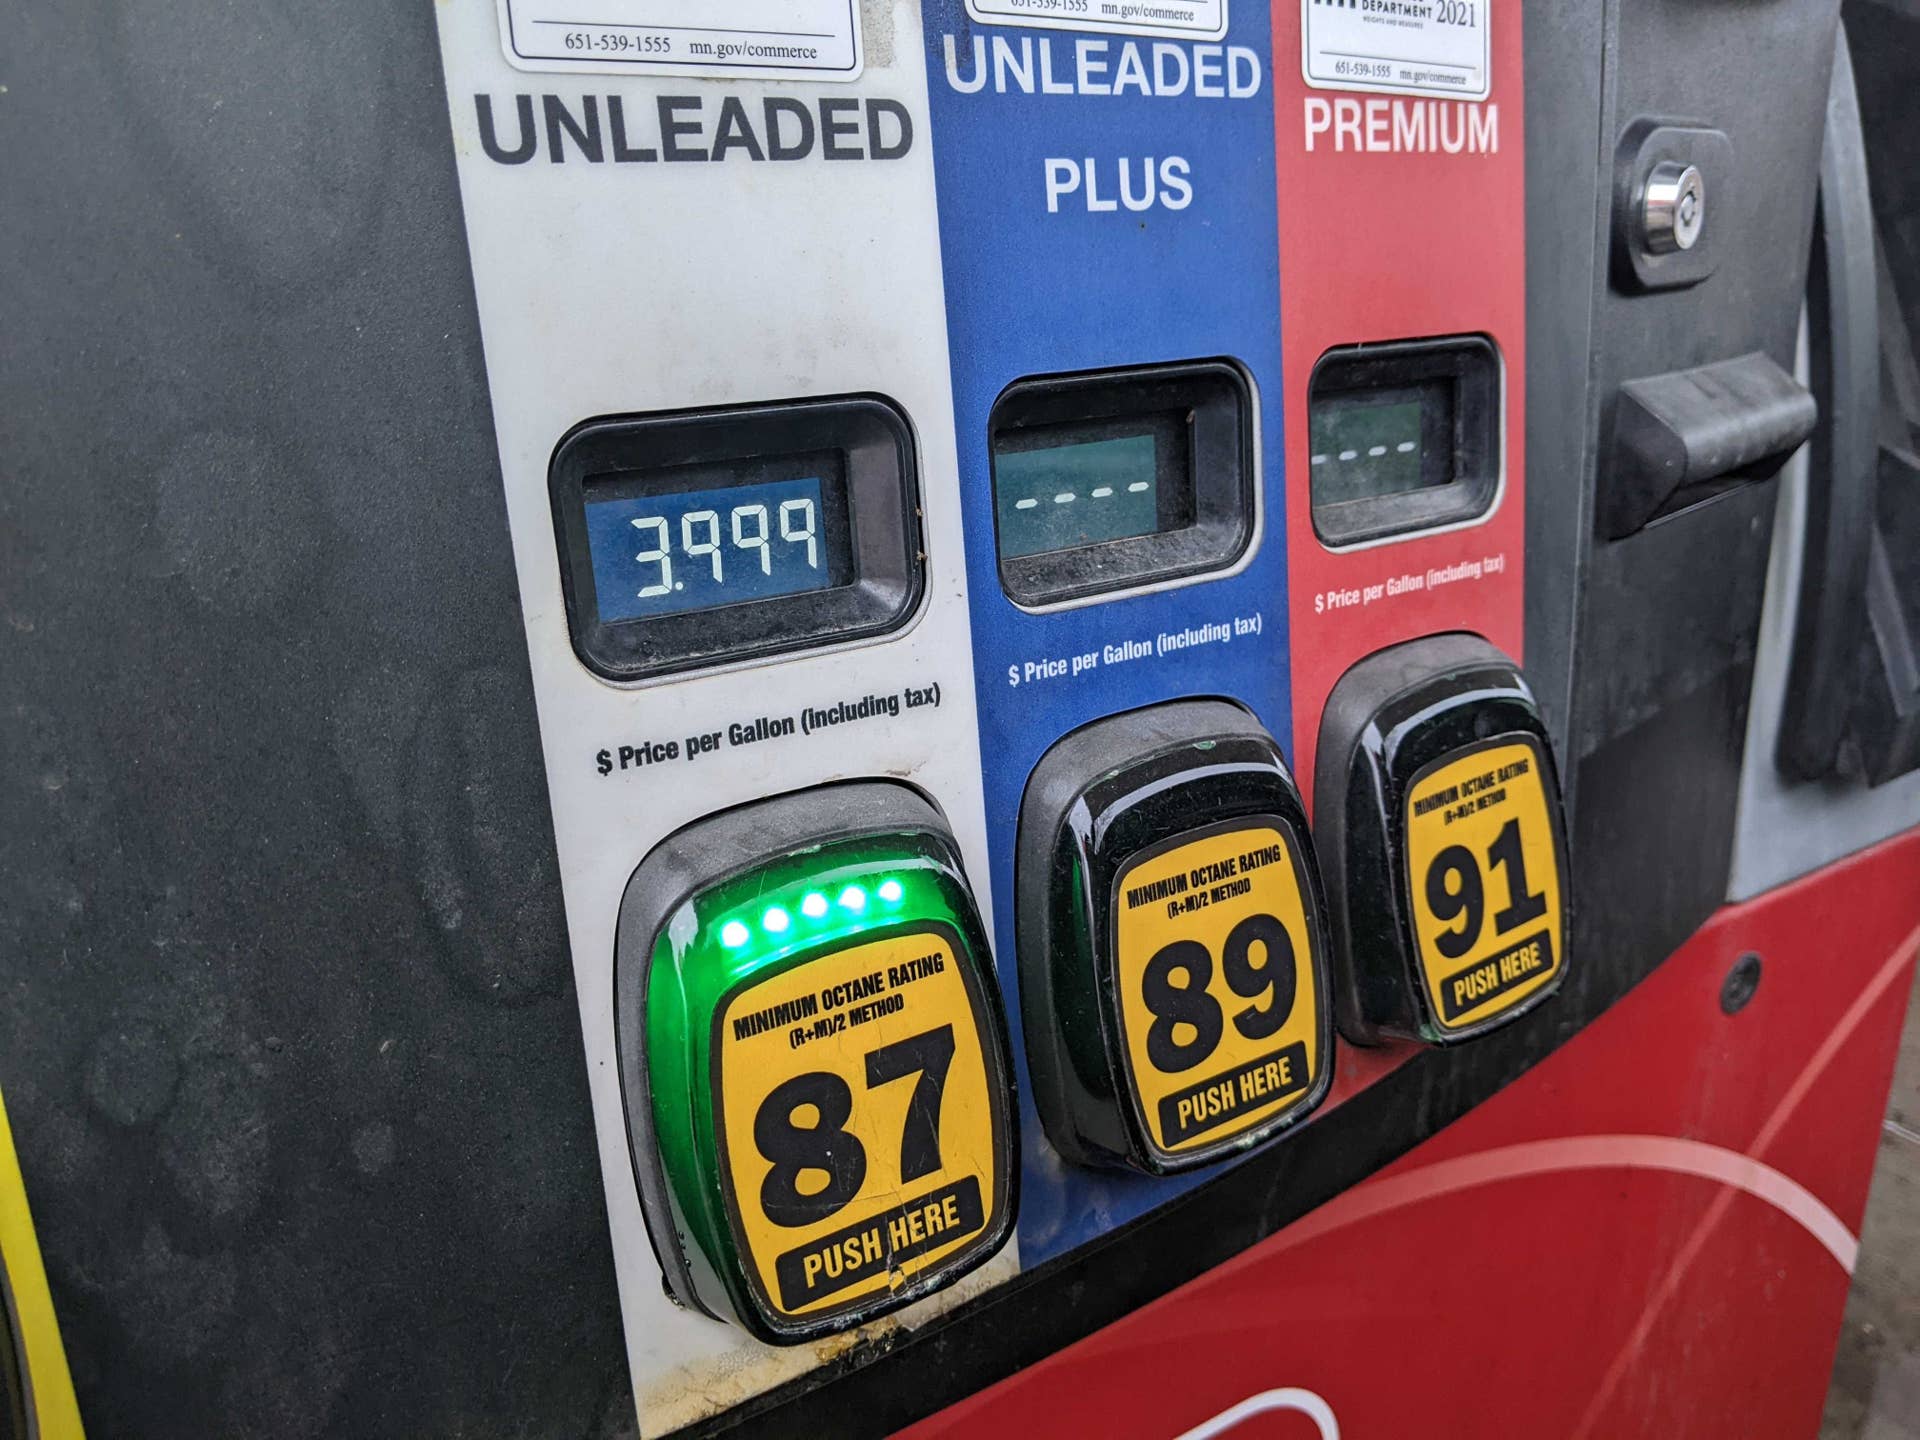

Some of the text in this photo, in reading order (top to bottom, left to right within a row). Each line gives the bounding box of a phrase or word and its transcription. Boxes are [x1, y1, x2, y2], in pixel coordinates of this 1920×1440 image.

[1101, 3, 1195, 21] mn.gov/commerce
[1362, 0, 1476, 27] DEPARTMENT 2021
[565, 33, 818, 60] 651-539-1555 mn.gov/commerce
[943, 34, 1262, 98] UNLEADED
[1335, 61, 1466, 85] 651-539-1555 mn.gov/commerce
[474, 93, 913, 165] UNLEADED
[1304, 97, 1499, 154] PREMIUM
[1045, 155, 1193, 213] PLUS
[631, 498, 818, 598] 3.999
[1314, 553, 1504, 614] $ Price per Gallon (including tax)
[1008, 612, 1262, 687] $ Price per Gallon (including tax)
[596, 682, 941, 777] $ Price per Gallon (including tax)
[1413, 758, 1528, 817] MINIMUM OCTANE RATING
[1476, 788, 1506, 811] METHOD
[1127, 844, 1281, 910] MINIMUM OCTANE RATING
[1167, 877, 1251, 919] (R+M)/2 METHOD
[1425, 817, 1548, 958] 91
[733, 952, 945, 1042] MINIMUM OCTANE RATING
[1142, 913, 1297, 1074] 89
[1453, 941, 1542, 1007] PUSH HERE
[789, 993, 904, 1050] (R+M)/2 METHOD
[753, 1022, 955, 1228] 87
[1177, 1056, 1293, 1130] PUSH HERE
[802, 1194, 961, 1288] PUSH HERE
